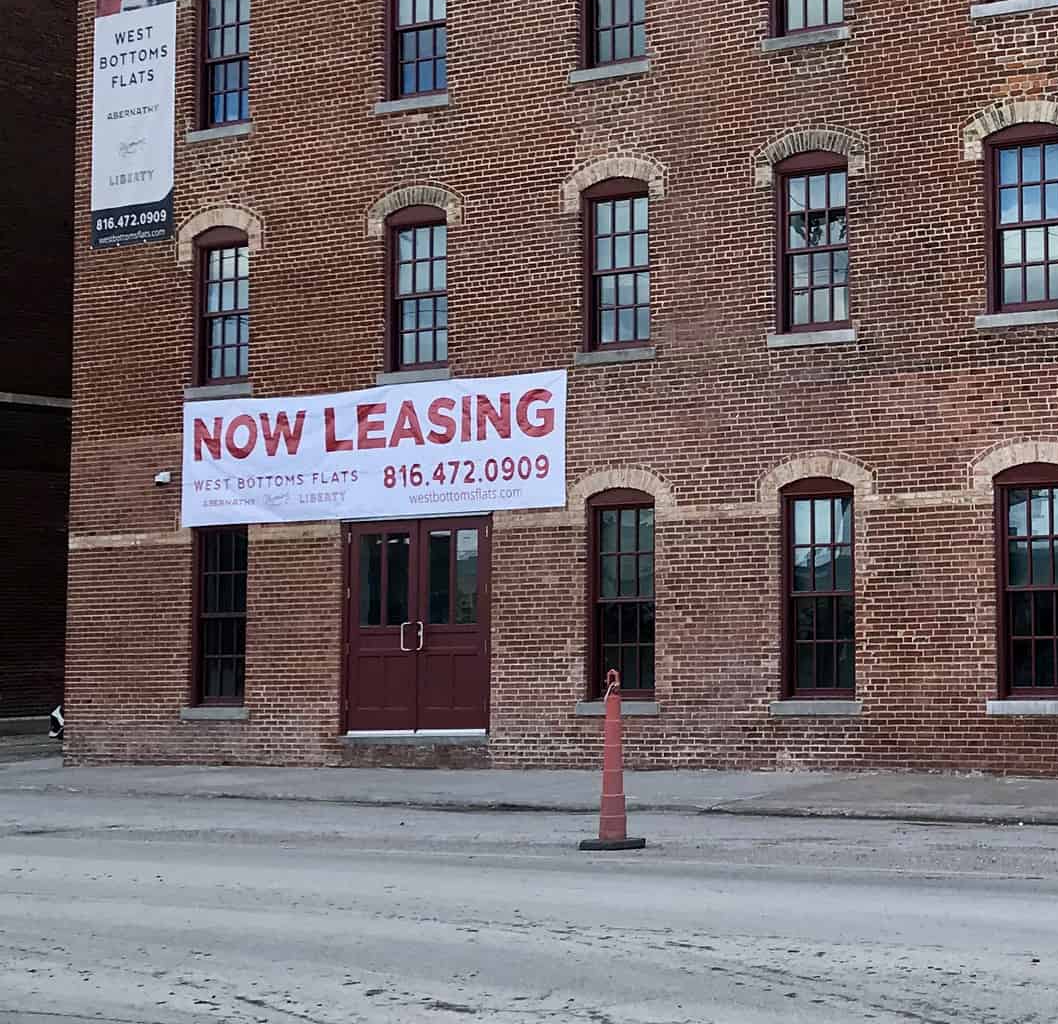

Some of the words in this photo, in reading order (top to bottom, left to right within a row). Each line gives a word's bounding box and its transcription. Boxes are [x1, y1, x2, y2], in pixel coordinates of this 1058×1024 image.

[114, 26, 153, 45] WEST
[99, 45, 168, 70] BOTTOMS
[111, 69, 154, 88] FLATS
[107, 104, 160, 120] ABERNATHY
[96, 209, 167, 231] 816.472.0909
[194, 410, 307, 461] NOW
[324, 389, 555, 452] LEASING
[383, 454, 549, 488] 816.472.0909
[194, 478, 231, 493] WEST
[237, 474, 304, 490] BOTTOMS
[312, 470, 359, 485] FLATS
[299, 490, 346, 504] LIBERTY
[408, 487, 522, 505] westbottomsflats.com
